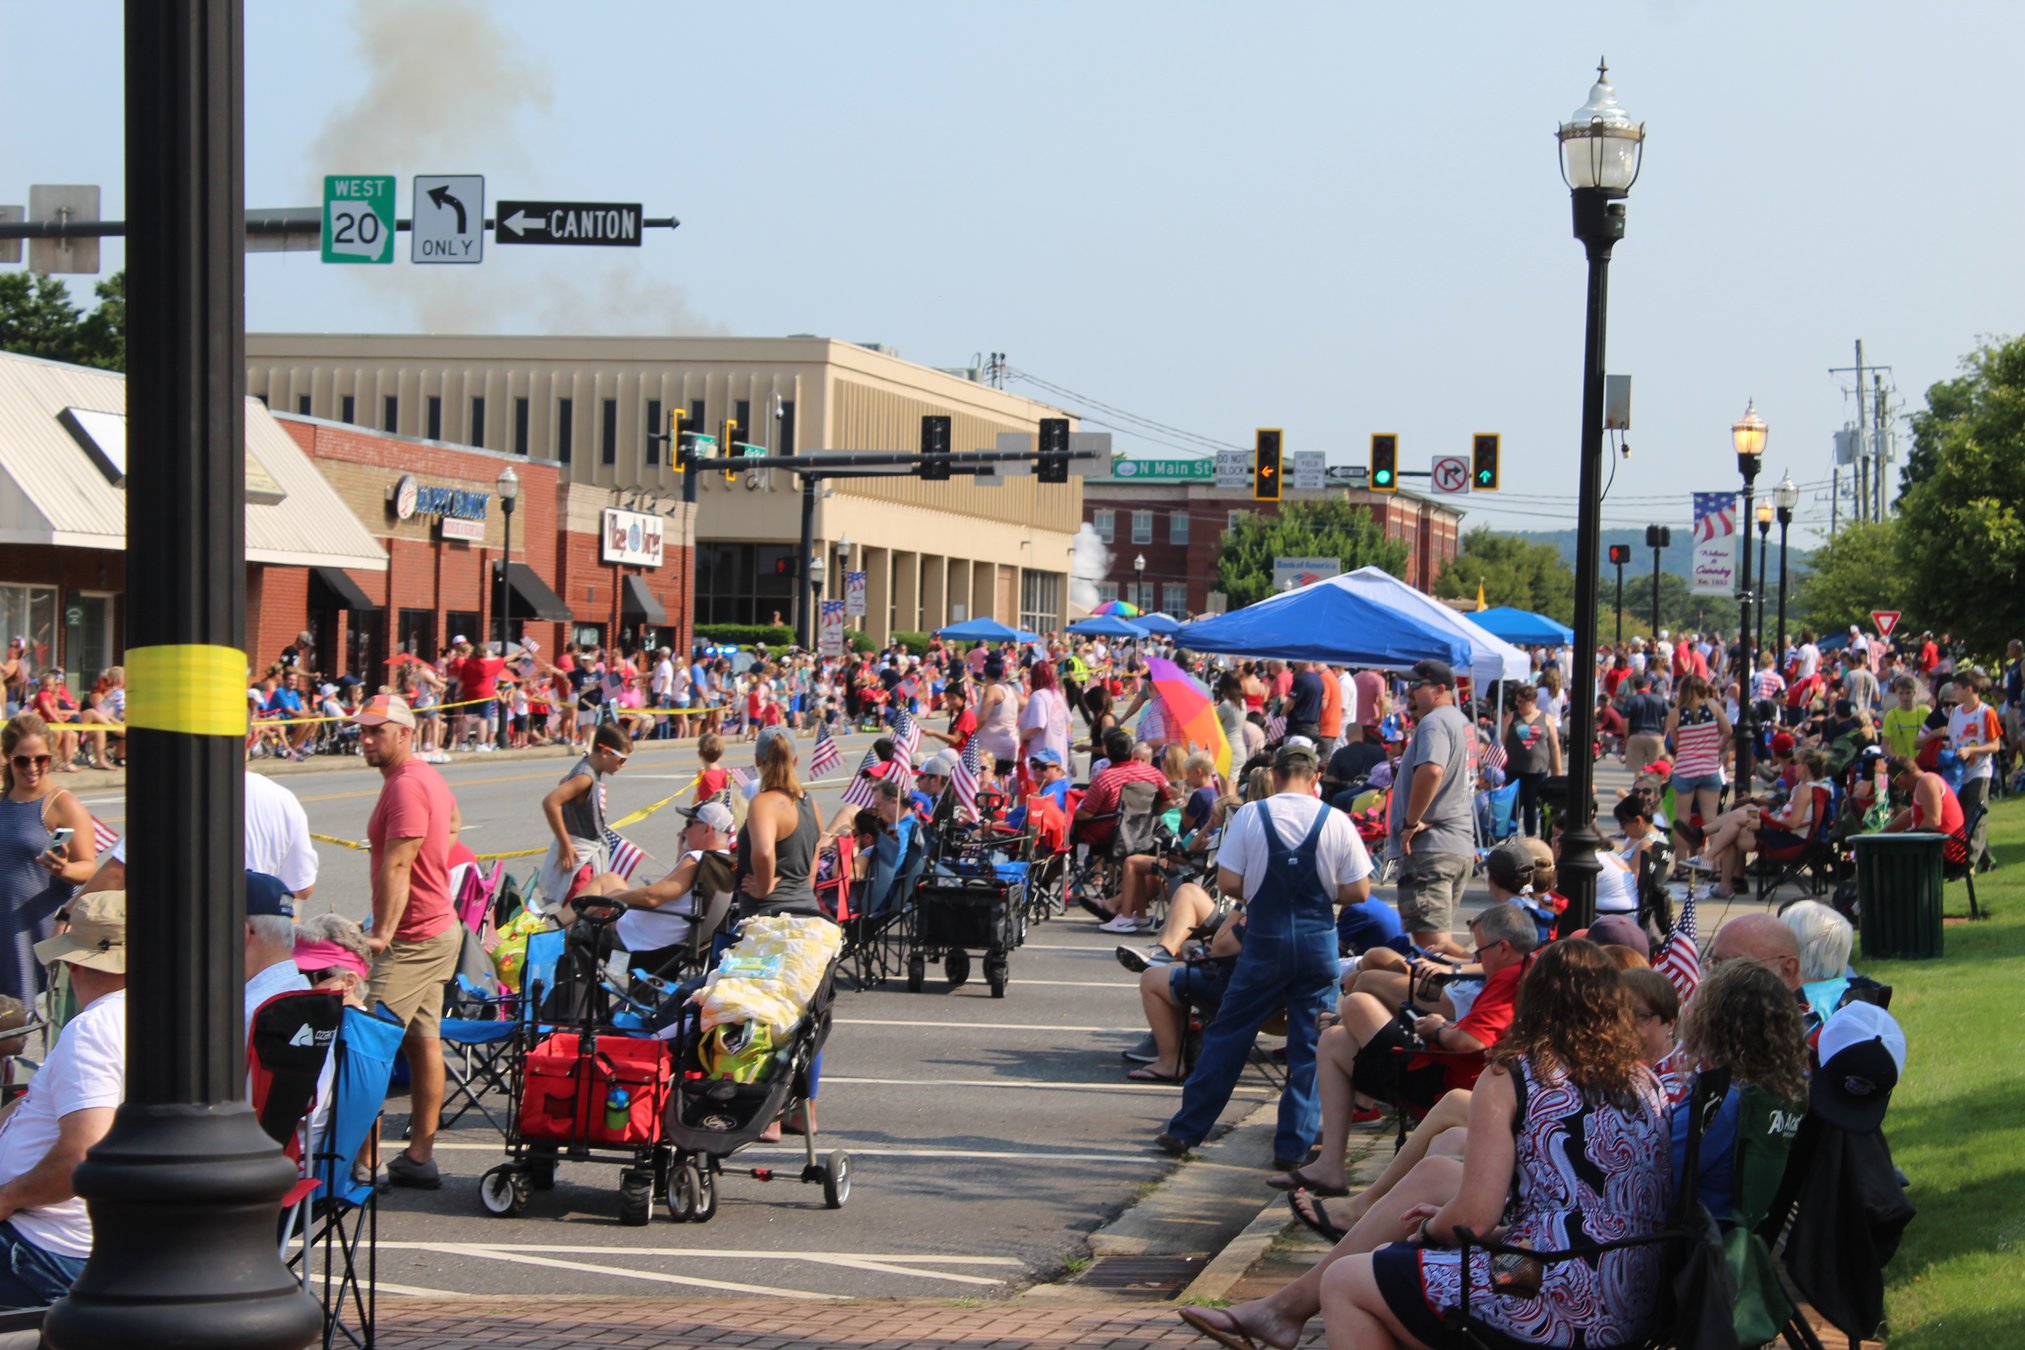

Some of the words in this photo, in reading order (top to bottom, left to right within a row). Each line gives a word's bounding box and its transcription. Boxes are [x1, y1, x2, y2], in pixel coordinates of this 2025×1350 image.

[335, 180, 385, 197] WEST
[334, 212, 379, 244] 20
[550, 209, 636, 240] CANTON
[422, 240, 473, 256] ONLY
[1217, 454, 1228, 463] DO
[1230, 454, 1247, 463] NOT
[1139, 461, 1149, 475] N
[1155, 461, 1188, 475] Main
[1194, 461, 1210, 475] St
[1218, 465, 1245, 476] BLOCK
[1276, 560, 1295, 569] Bank
[1296, 560, 1304, 569] of
[1305, 560, 1337, 569] America
